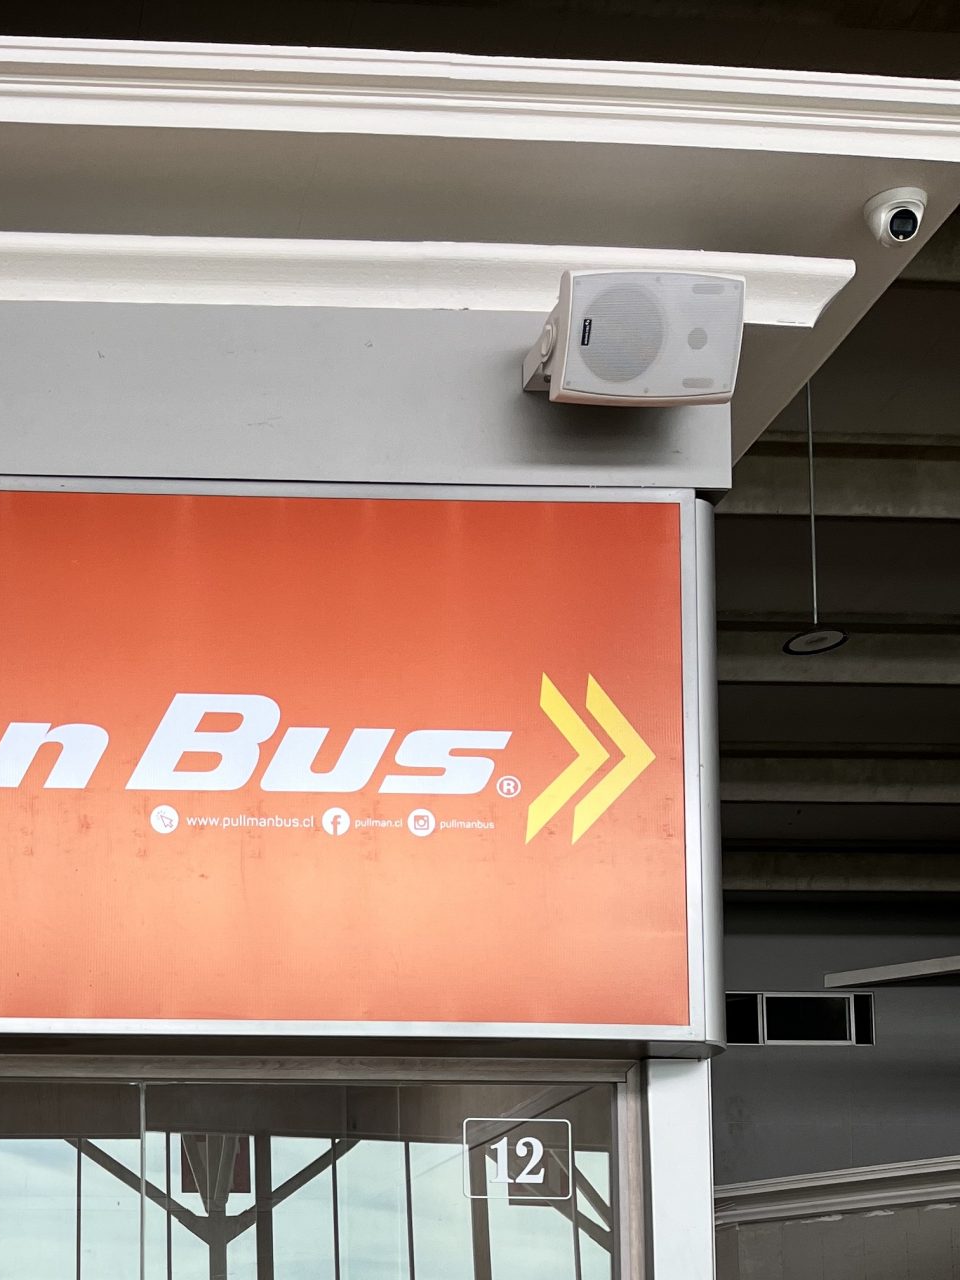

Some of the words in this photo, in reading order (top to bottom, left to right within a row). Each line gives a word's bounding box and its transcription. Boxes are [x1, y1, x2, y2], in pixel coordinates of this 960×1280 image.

[125, 693, 513, 794] Bus
[186, 815, 314, 829] www.pullmanbus.cl
[355, 818, 403, 829] pullman.cl
[440, 818, 495, 830] pullmanbus
[489, 1136, 546, 1184] 12
